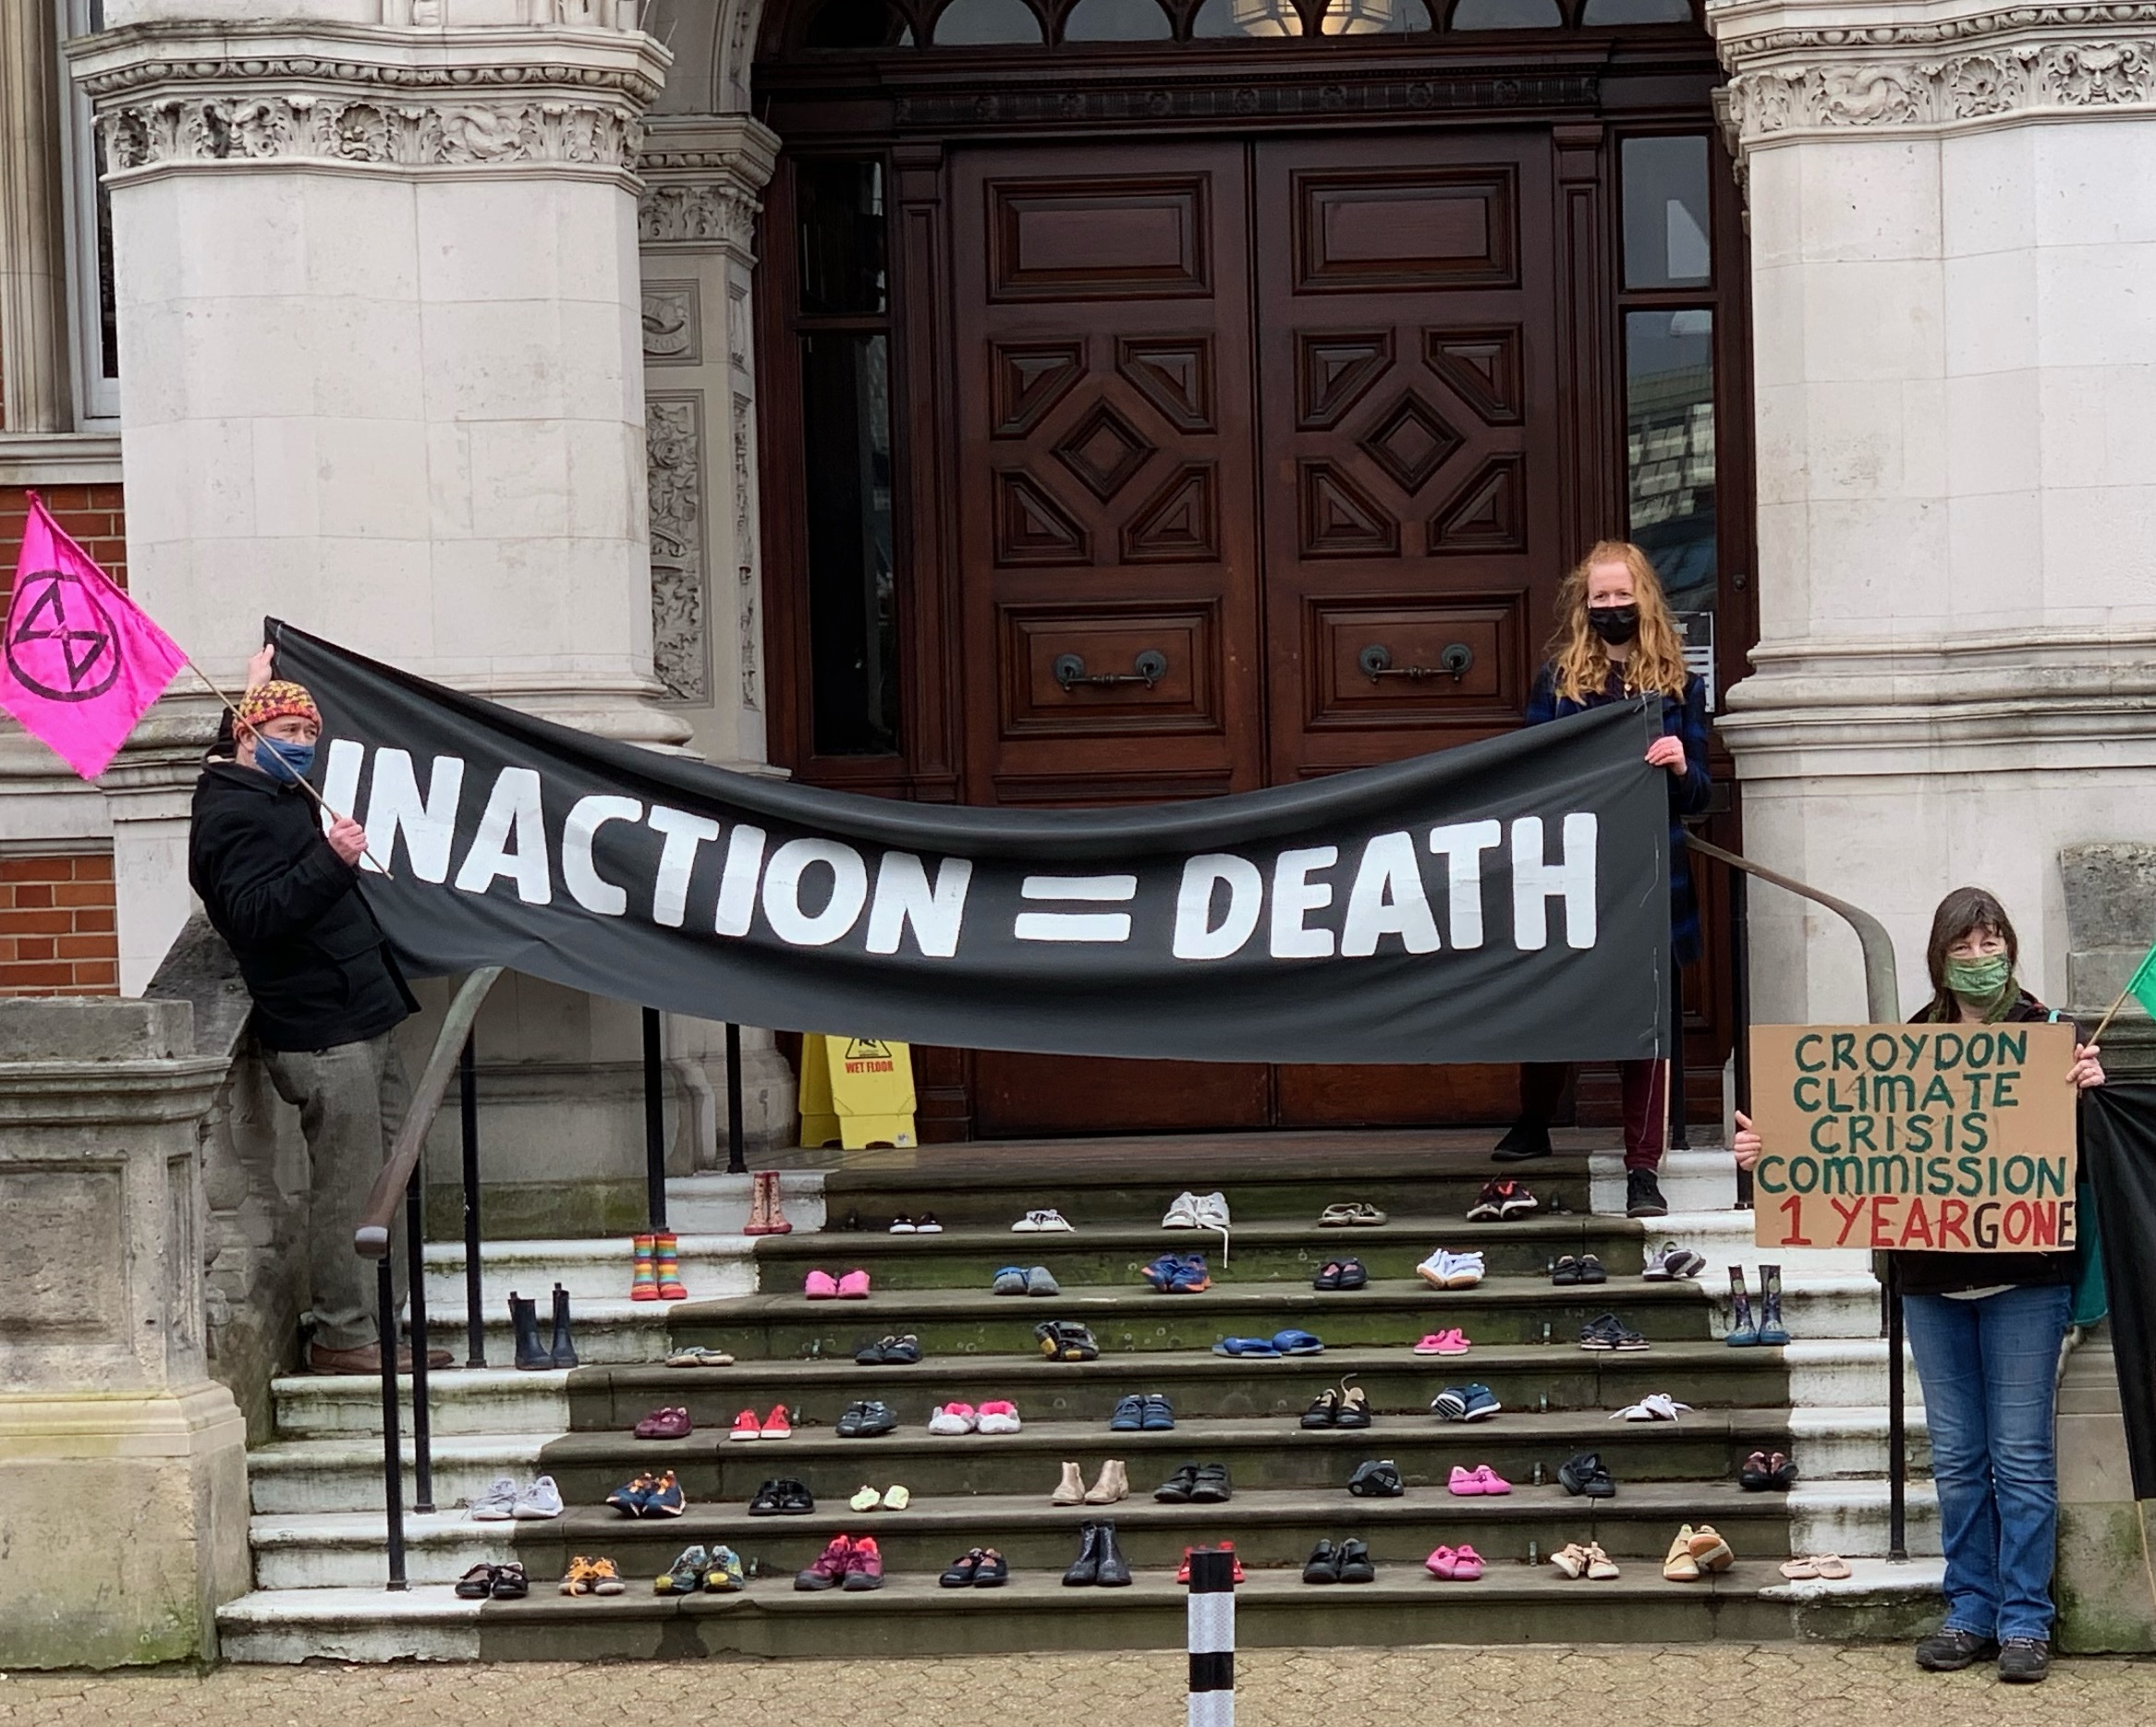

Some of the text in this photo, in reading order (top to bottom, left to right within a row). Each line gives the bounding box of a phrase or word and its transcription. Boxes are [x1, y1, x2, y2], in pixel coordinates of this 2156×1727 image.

[320, 738, 1598, 961] INACTION = DEATH
[845, 1060, 895, 1074] WET FLOOR
[1795, 1029, 2028, 1073] CROYDON
[1793, 1071, 2021, 1113] CLIMATE
[1809, 1112, 1989, 1154] CRISIS
[1757, 1153, 2067, 1199] COMMISSION
[1780, 1195, 1812, 1246] 1
